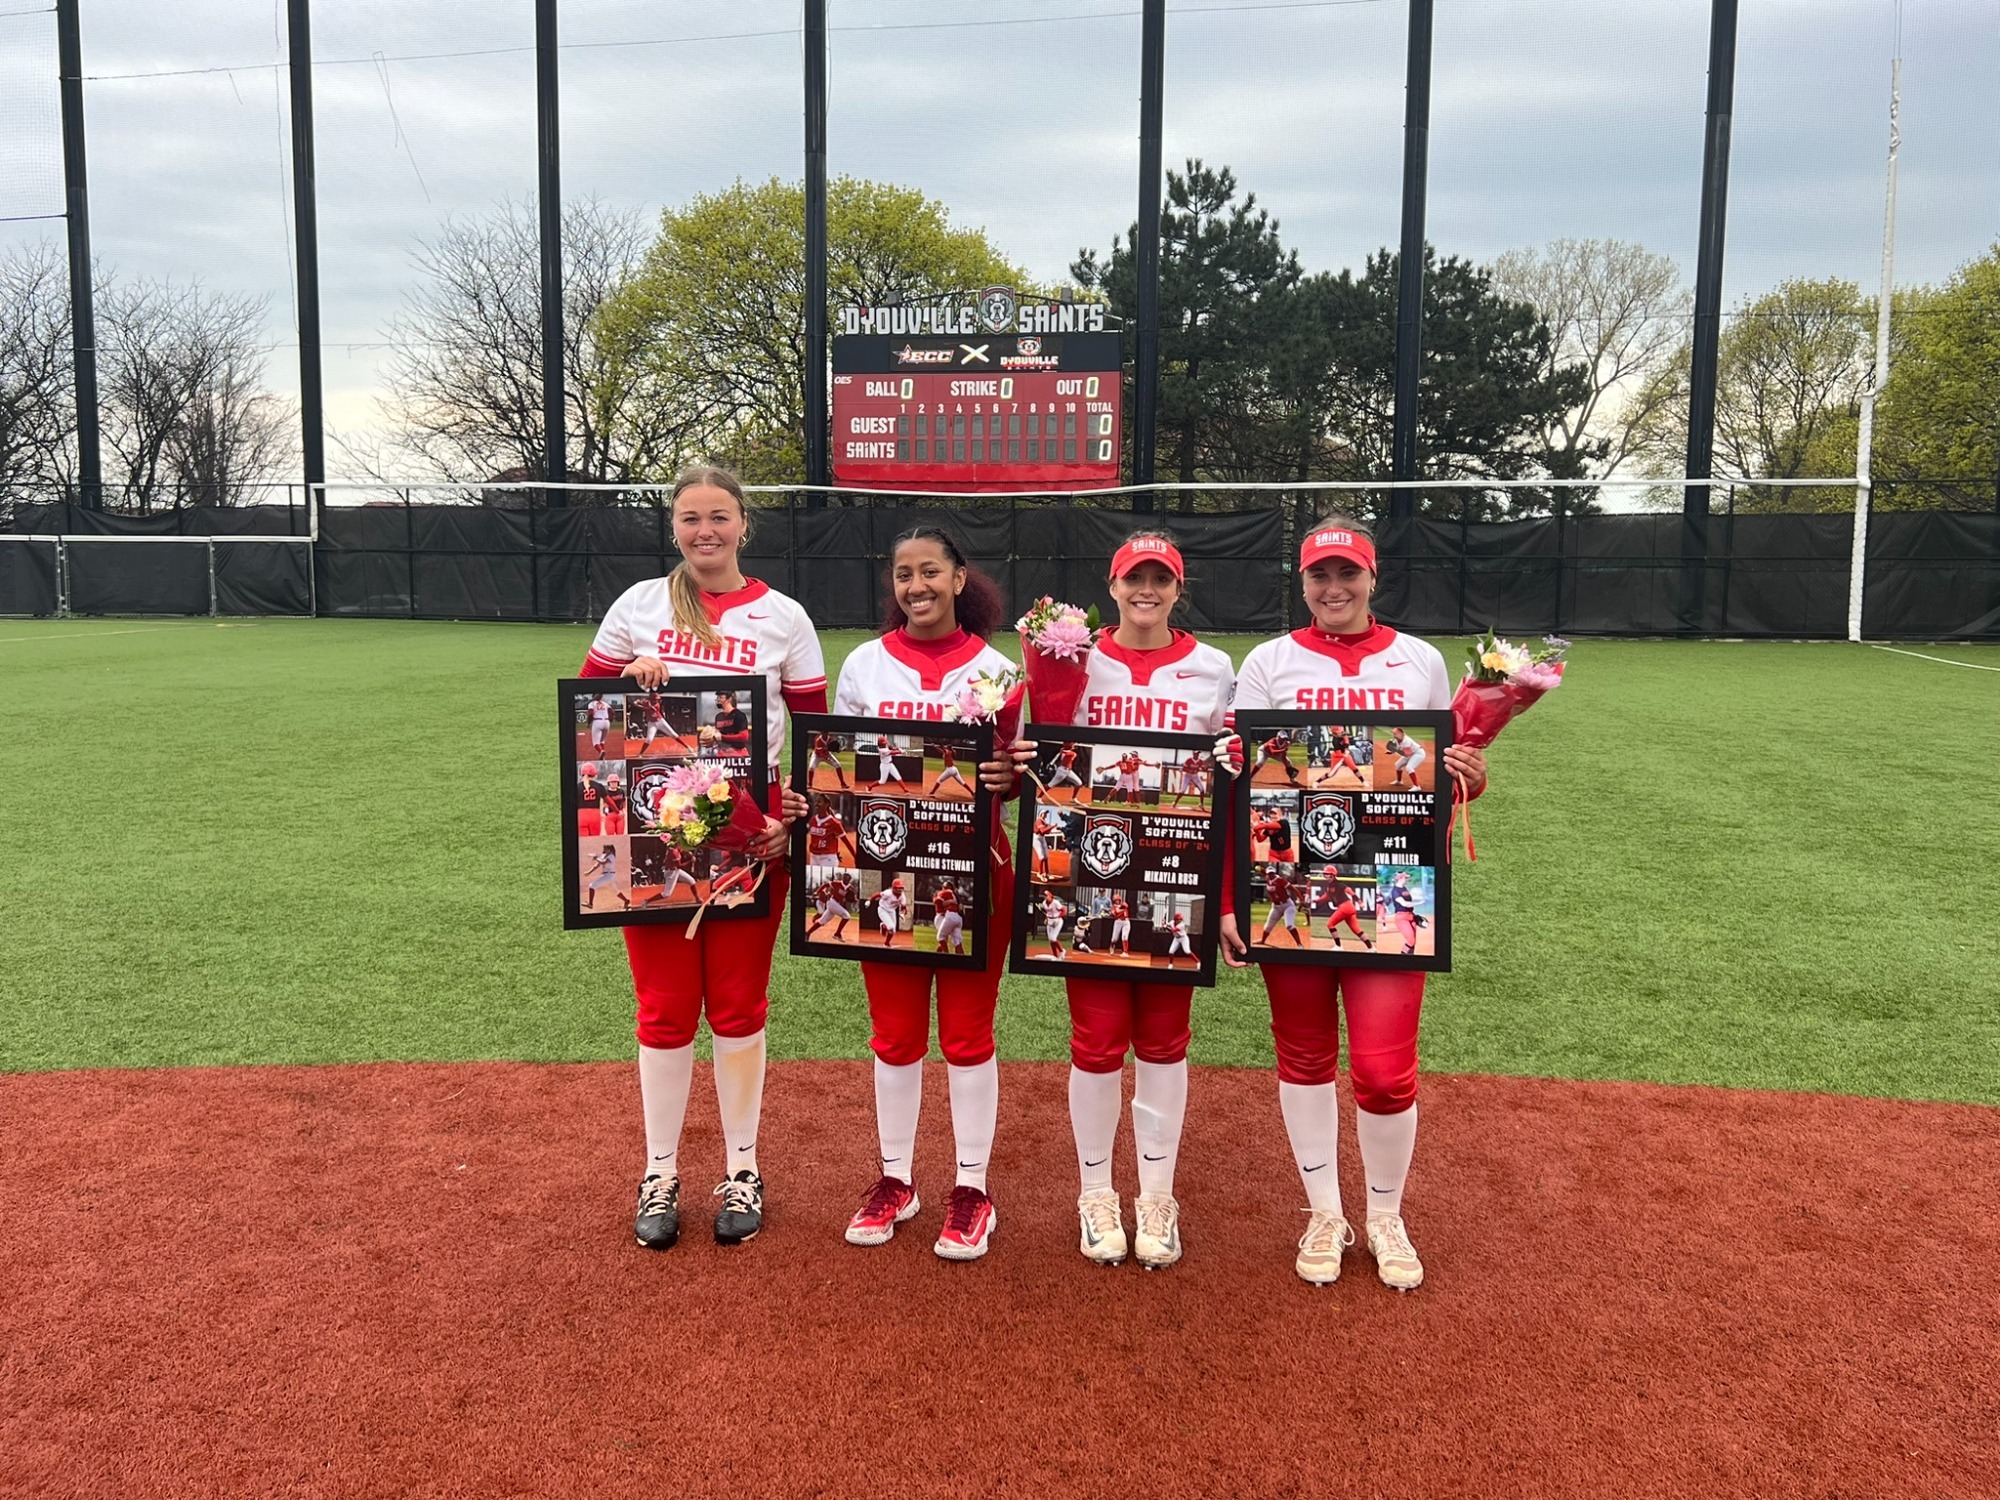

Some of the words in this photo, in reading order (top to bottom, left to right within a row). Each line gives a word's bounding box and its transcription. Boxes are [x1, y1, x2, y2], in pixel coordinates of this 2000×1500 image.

[866, 381, 898, 396] BALL
[901, 379, 913, 399] 0
[951, 381, 997, 396] STRIKE
[1000, 378, 1013, 399] 0
[1056, 380, 1083, 395] OUT
[1085, 377, 1099, 398] 0
[901, 404, 906, 413] 1
[918, 404, 925, 413] 2
[938, 404, 944, 413] 3
[956, 404, 963, 413] 4
[974, 404, 981, 413] 5
[993, 403, 999, 413] 6
[1012, 403, 1018, 413] 7
[1030, 403, 1036, 413] 8
[1049, 403, 1055, 413] 9
[1065, 403, 1076, 413] 10
[1086, 402, 1113, 413] TOTAL
[851, 417, 896, 434] GUEST
[1099, 414, 1112, 435] 0
[846, 442, 895, 458] SAINTS
[1099, 440, 1112, 460] 0
[1315, 531, 1352, 545] SAINTS
[1132, 539, 1167, 553] SAINTS
[1088, 696, 1188, 731] SAINTS
[584, 789, 596, 800] 22
[1361, 793, 1434, 803] D'YOUVILLE
[909, 800, 975, 813] D'YOUVILLE
[1366, 804, 1429, 815] SOFTBALL
[914, 811, 970, 823] SOFTBALL
[1141, 816, 1210, 829] D'YOUVILLE
[1362, 816, 1396, 824] CLASS
[1400, 817, 1414, 825] OF
[909, 822, 939, 832] CLASS
[1145, 827, 1204, 840] SOFTBALL
[928, 842, 950, 854] #16
[1139, 839, 1171, 848] CLASS
[1175, 841, 1189, 849] OF
[1383, 836, 1406, 849] #11
[906, 856, 940, 869] ASHLEIGH
[941, 858, 974, 872] STEWART
[1162, 855, 1179, 868] #8
[1374, 853, 1390, 865] AVA
[1391, 853, 1419, 865] MILLER
[1144, 870, 1176, 884] MIKAYLA
[1177, 872, 1199, 885] BUSH
